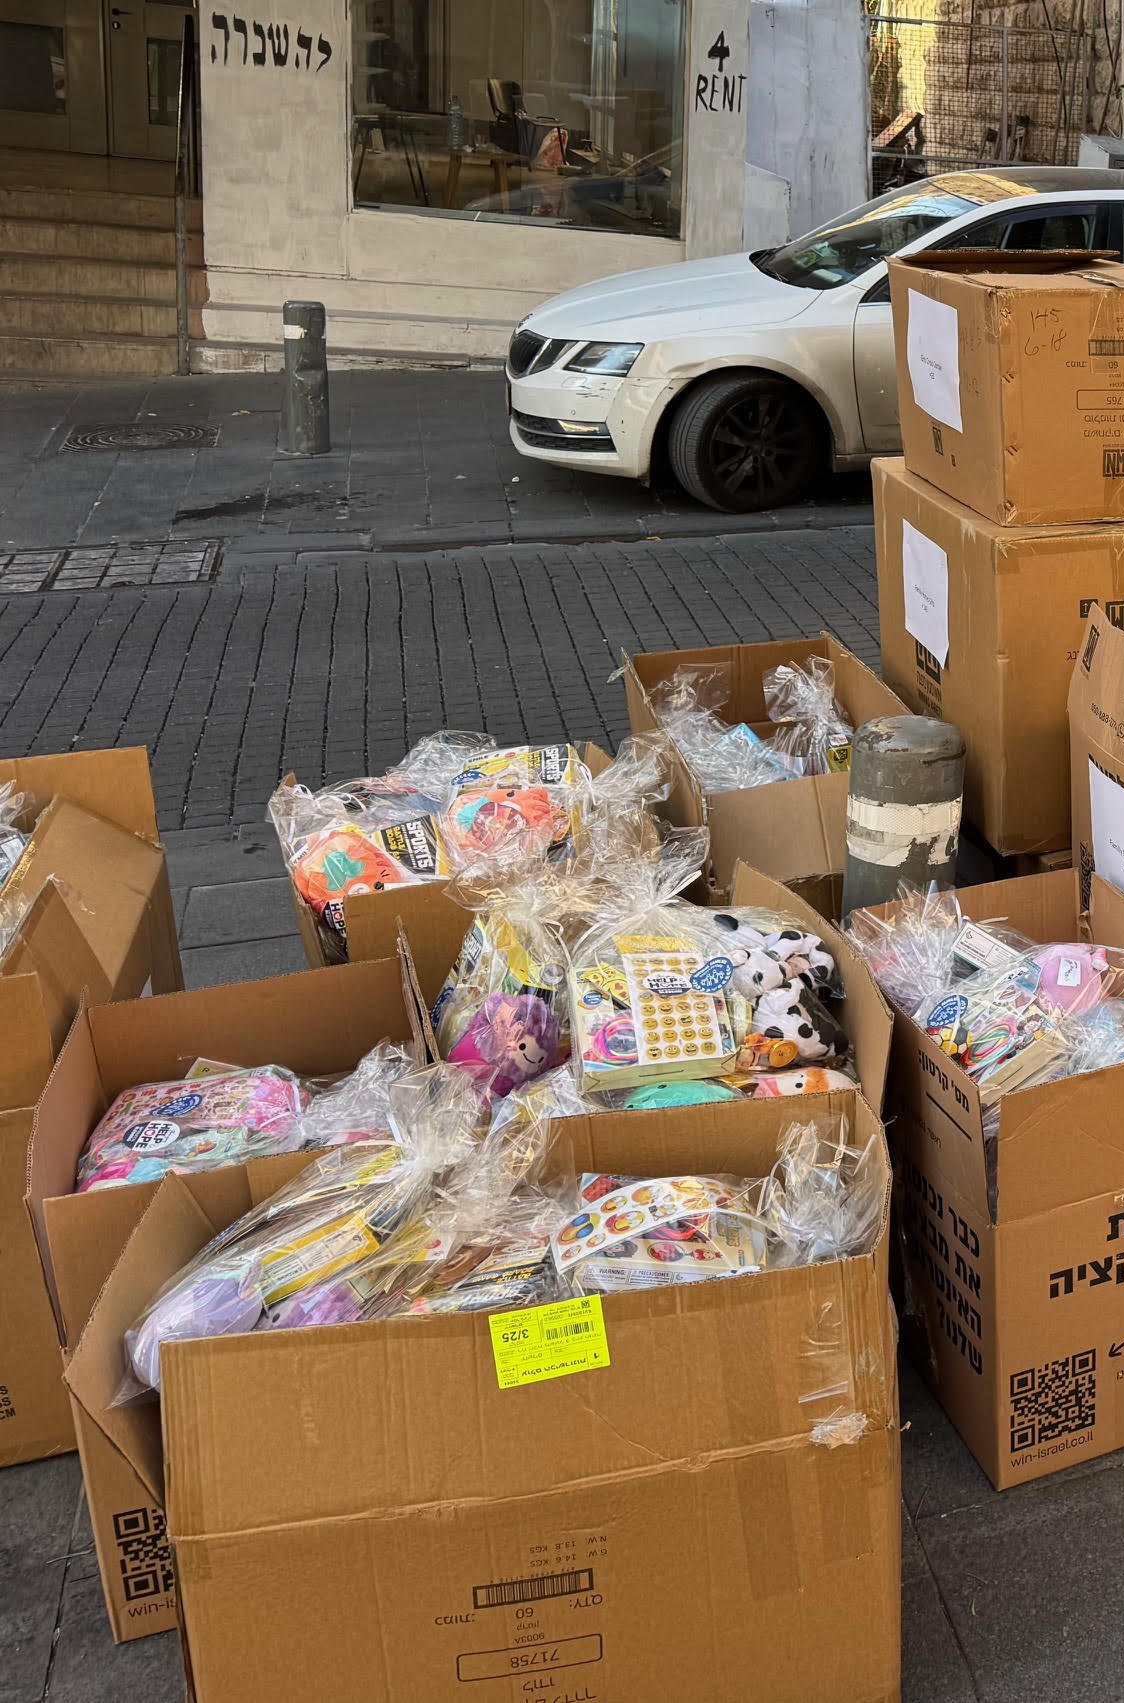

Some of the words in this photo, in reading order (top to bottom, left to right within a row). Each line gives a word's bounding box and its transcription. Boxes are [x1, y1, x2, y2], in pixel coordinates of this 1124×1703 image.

[210, 11, 333, 73] להשכרה
[708, 30, 730, 72] 4
[695, 73, 748, 112] RENT
[1108, 361, 1119, 369] 60
[1084, 414, 1116, 424] סולמות
[1083, 428, 1120, 438] משחקים
[406, 820, 434, 869] SPORTS
[135, 1122, 161, 1149] HOPE
[153, 1123, 173, 1144] HELP
[947, 1205, 980, 1258] כבר
[955, 1250, 982, 1301] את
[502, 1328, 529, 1343] 3/25
[521, 1367, 543, 1377] עולם
[1010, 1429, 1095, 1469] win-israel.co.il
[569, 1593, 603, 1610] QTY:
[434, 1613, 475, 1626] כמות:
[515, 1607, 534, 1619] 60
[510, 1649, 560, 1669] 71758
